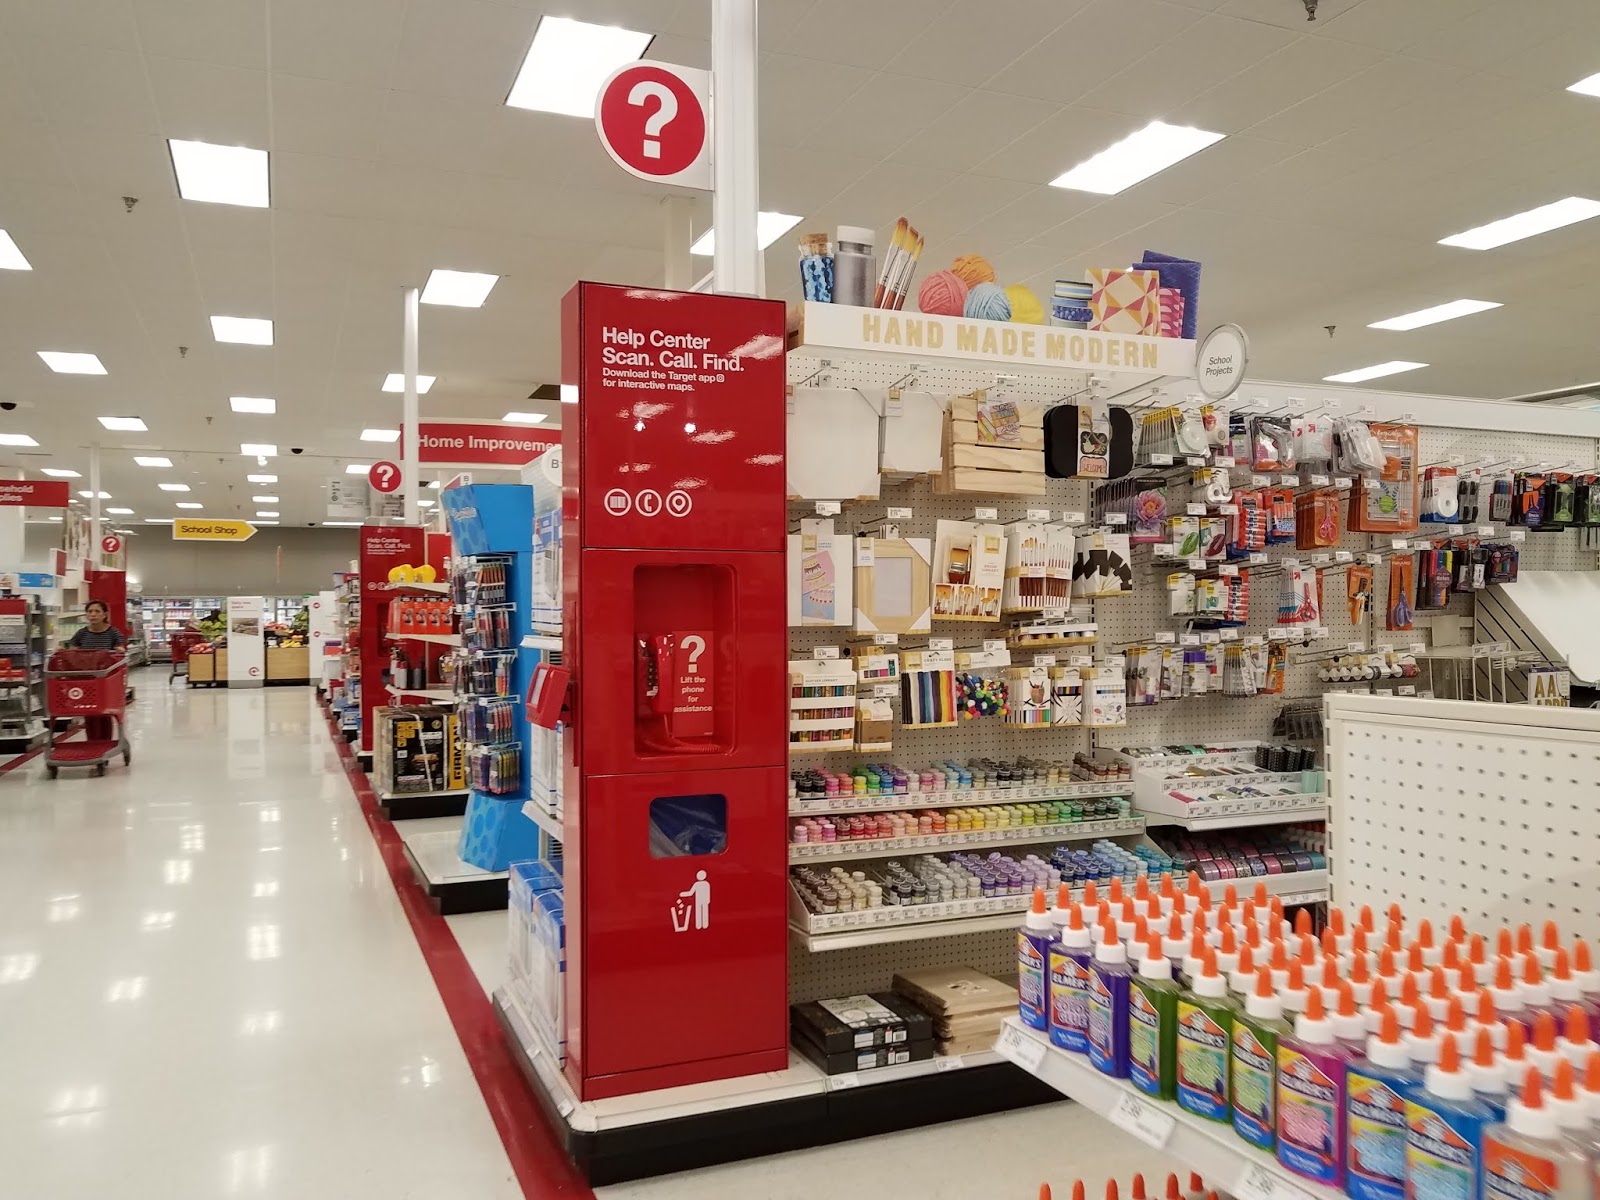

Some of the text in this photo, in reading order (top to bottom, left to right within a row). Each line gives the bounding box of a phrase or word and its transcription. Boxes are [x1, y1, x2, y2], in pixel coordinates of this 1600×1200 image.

[602, 326, 711, 350] Help Center
[862, 313, 1158, 369] HAND MADE MODERN
[602, 346, 745, 372] Scan. Call. Find.
[1208, 354, 1233, 366] School
[602, 367, 716, 384] Download the Target app
[1205, 365, 1234, 377] Projects
[602, 378, 695, 393] for interactive maps.
[418, 434, 562, 452] Home Improveme
[181, 525, 238, 536] School Shop
[680, 676, 693, 684] Lift
[681, 686, 705, 694] phone
[687, 695, 699, 703] for
[673, 705, 713, 713] assistance
